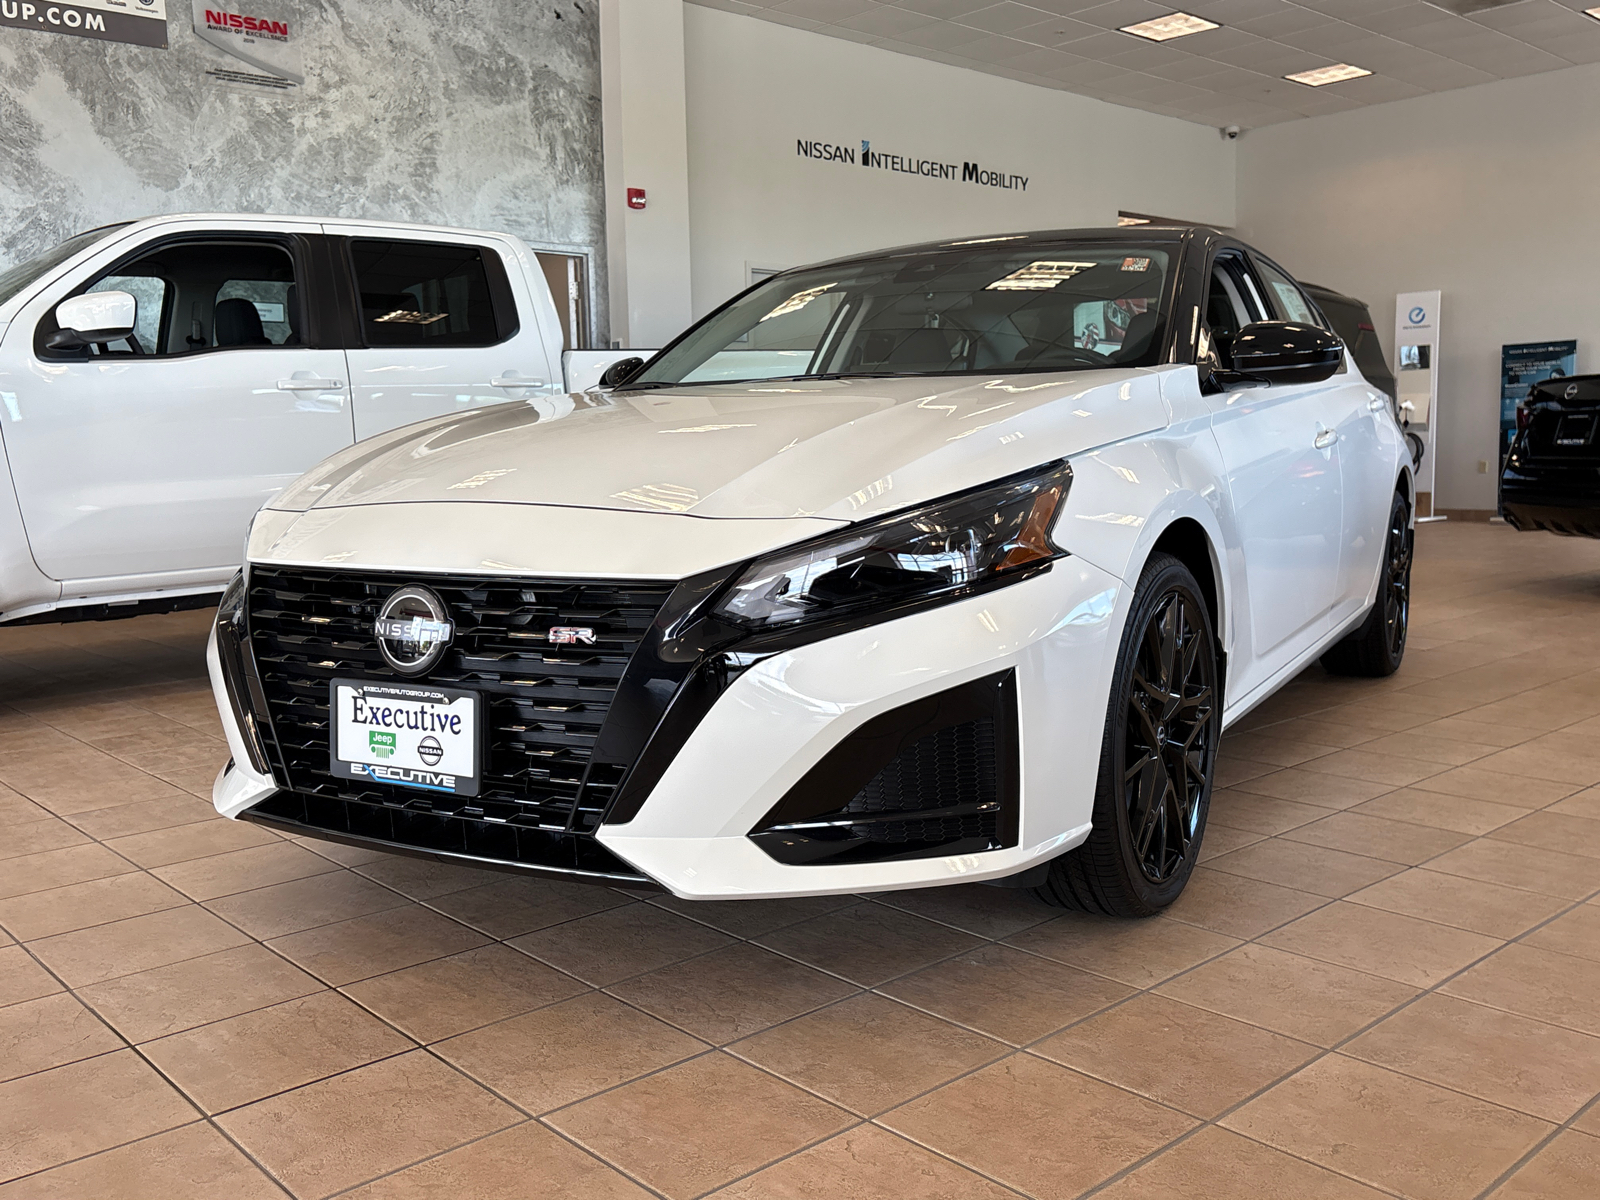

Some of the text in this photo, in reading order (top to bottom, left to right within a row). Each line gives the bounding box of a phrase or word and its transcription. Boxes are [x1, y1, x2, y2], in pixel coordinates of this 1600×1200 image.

[2, 0, 106, 32] UP.COM
[205, 10, 288, 35] NISSAN
[207, 24, 232, 33] AWARD
[245, 31, 288, 42] EXCELLENCE
[797, 139, 1029, 191] NISSAN INTELLIGENT MOBILITY
[375, 622, 449, 640] NISS
[549, 627, 597, 645] SR
[363, 686, 444, 699] EXECUTIVEAUTOGROUP.COM
[351, 696, 461, 735] Executive
[373, 732, 393, 745] Jeep
[419, 747, 442, 756] NISSAN
[351, 763, 456, 788] EXECUTIVE
